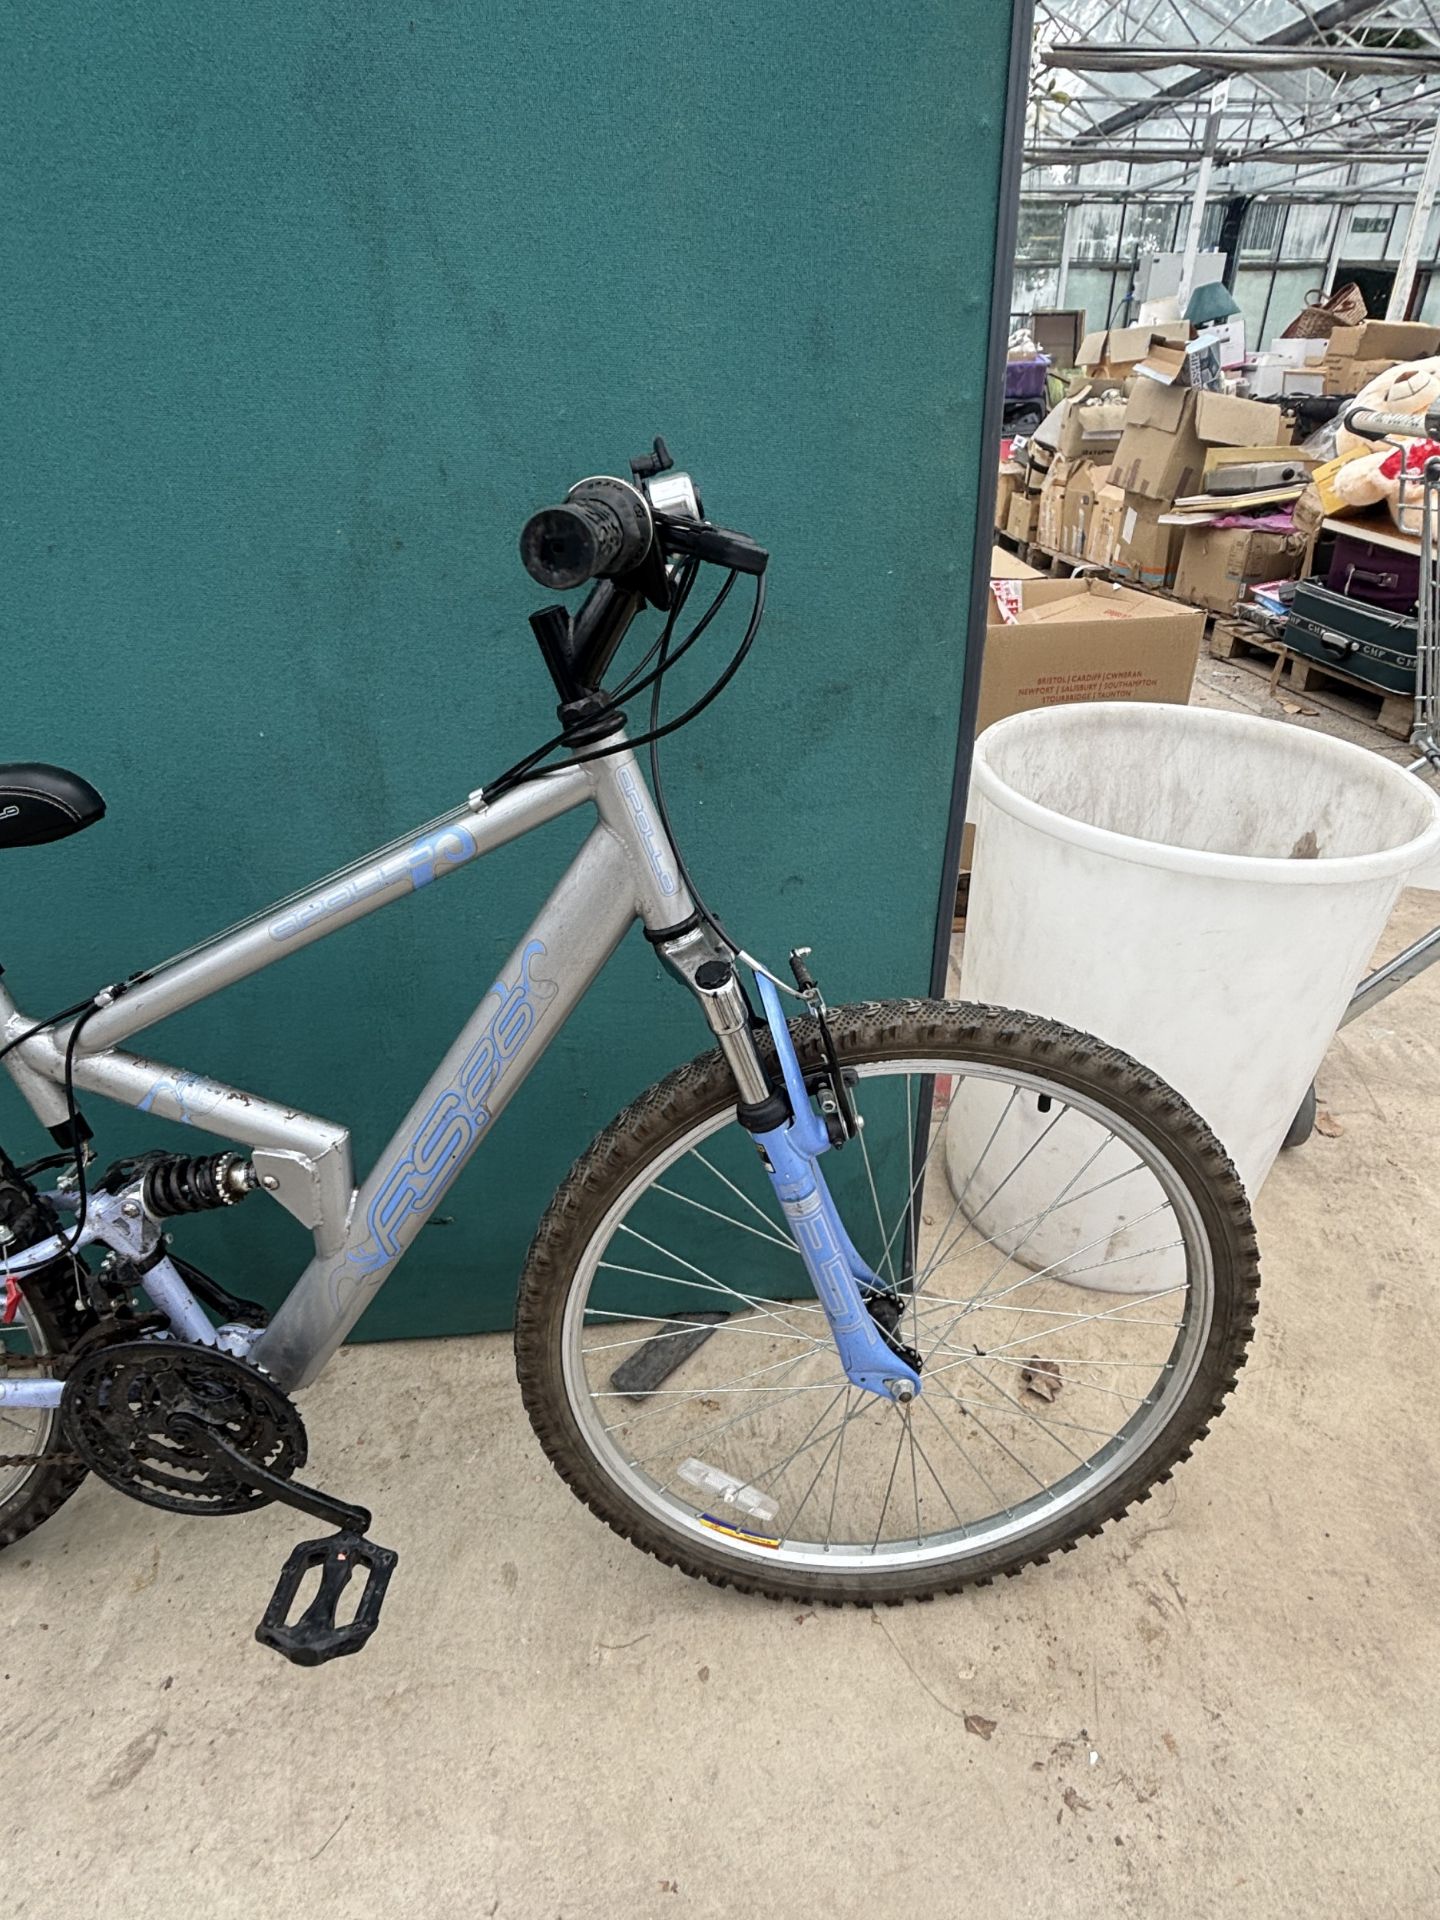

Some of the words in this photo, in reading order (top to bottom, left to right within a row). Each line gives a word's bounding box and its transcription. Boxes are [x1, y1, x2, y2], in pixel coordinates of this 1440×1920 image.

[1018, 686, 1054, 696] NEWPORT
[1104, 679, 1157, 689] SOUTHAMPTON
[1097, 689, 1131, 698] TAUNTON
